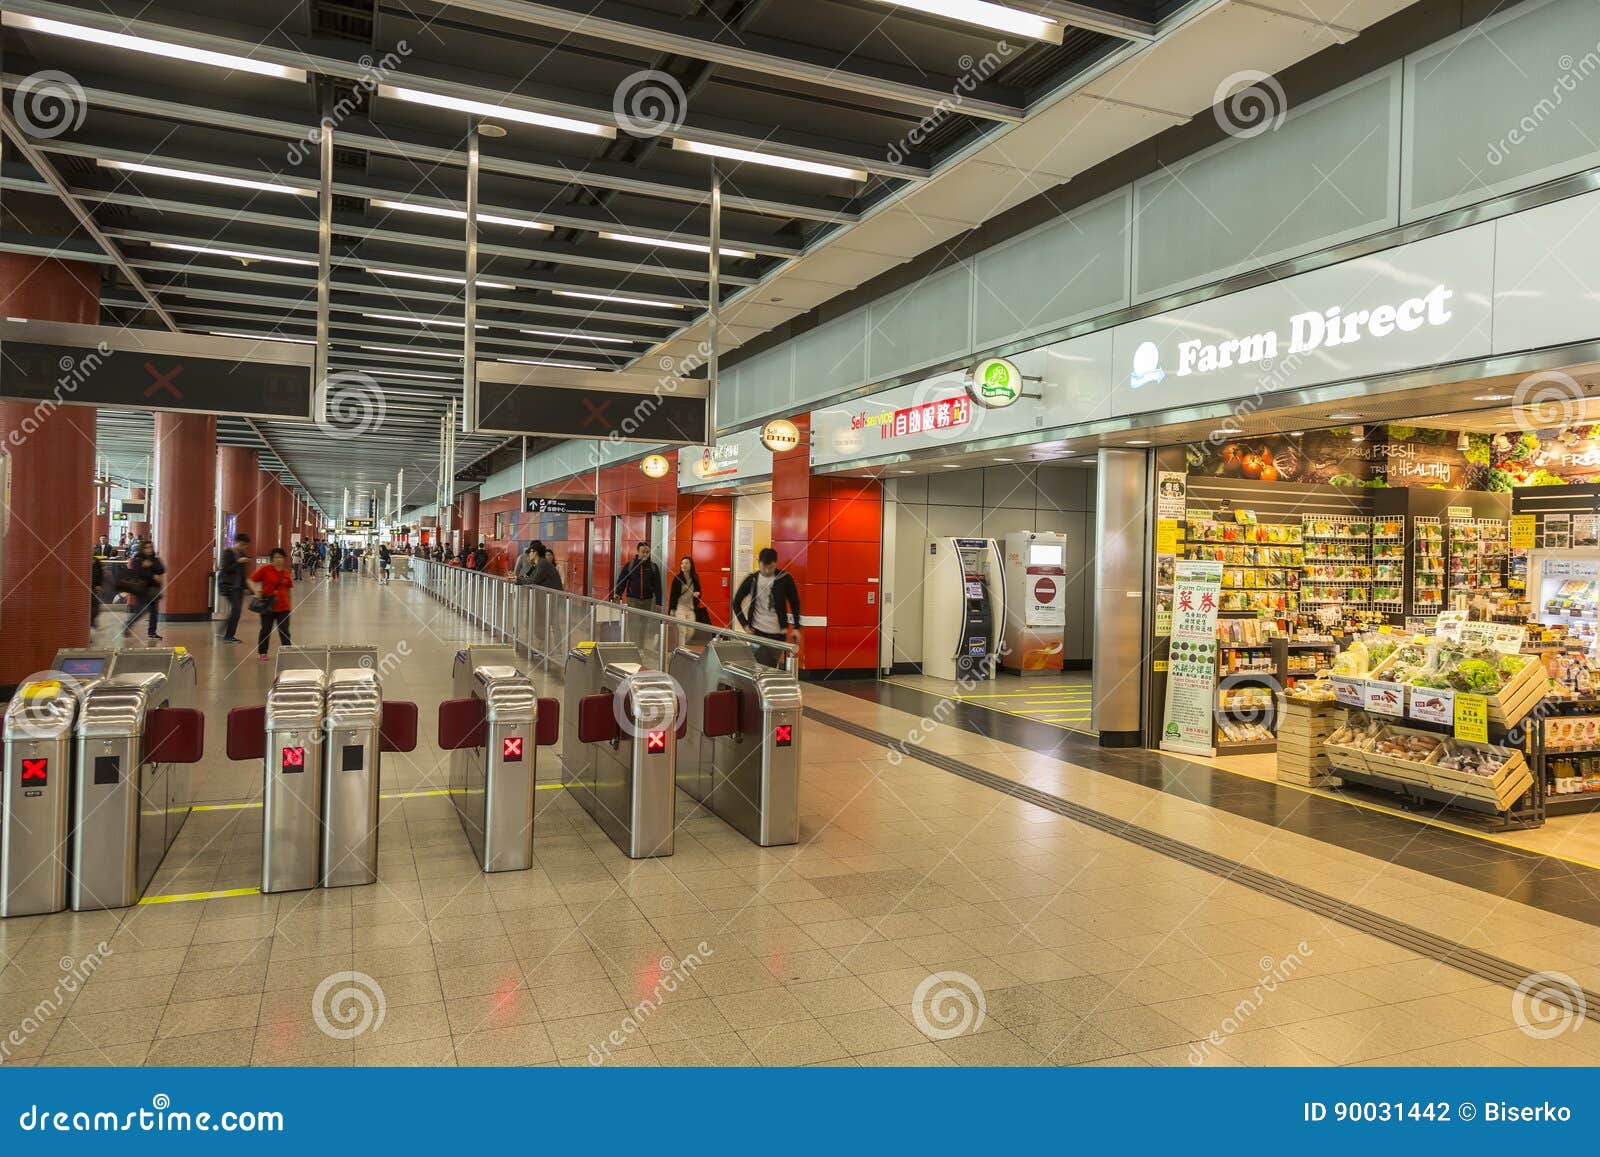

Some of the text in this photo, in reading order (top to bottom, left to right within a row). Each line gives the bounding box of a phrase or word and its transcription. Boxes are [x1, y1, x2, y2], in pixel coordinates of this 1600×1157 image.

[1177, 284, 1453, 376] Farm Direct
[896, 399, 968, 436] 自助服務站
[1373, 443, 1416, 460] FRESH
[1398, 459, 1451, 482] HEALTHY
